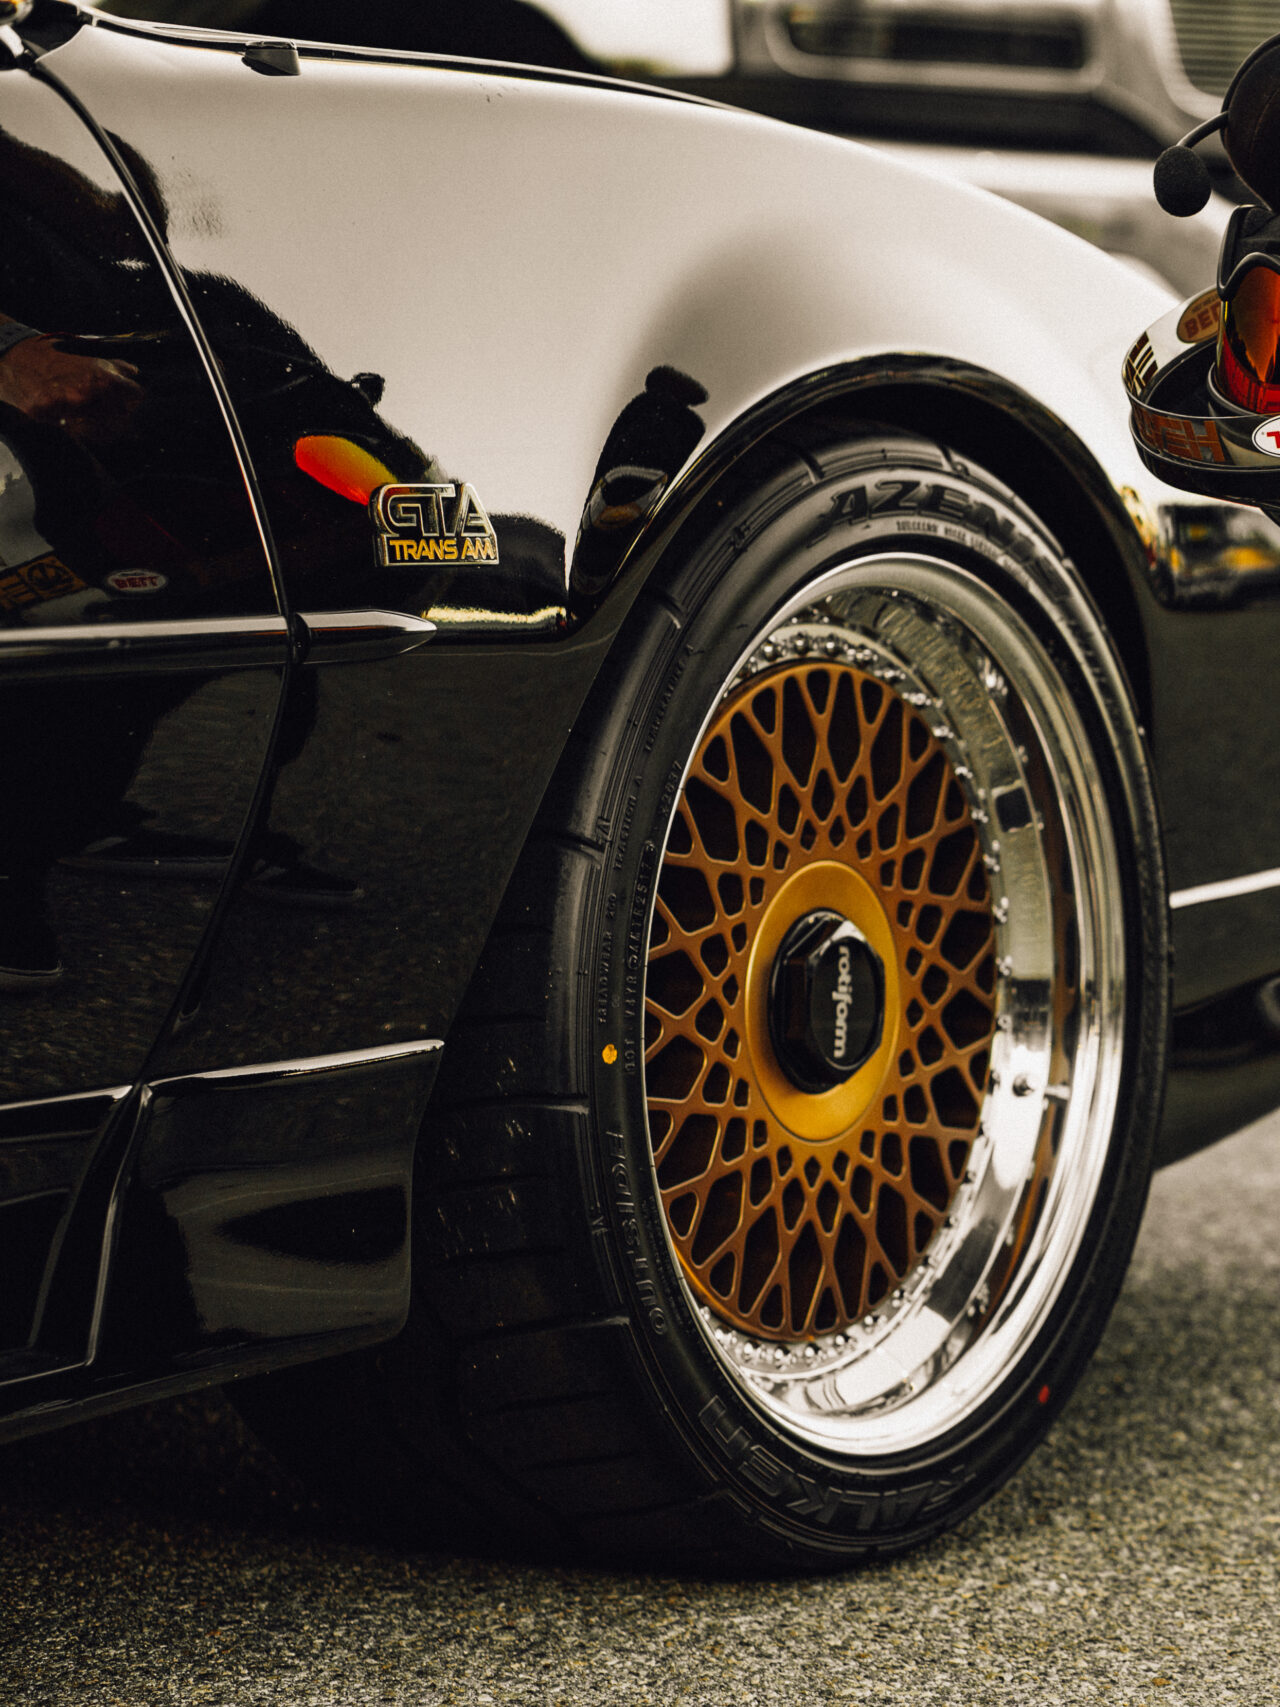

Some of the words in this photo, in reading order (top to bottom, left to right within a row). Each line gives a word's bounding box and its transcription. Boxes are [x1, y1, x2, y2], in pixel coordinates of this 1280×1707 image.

[379, 483, 491, 537] GTA
[389, 539, 459, 560] TRANS
[461, 537, 497, 560] AM
[832, 945, 853, 1059] rotiform
